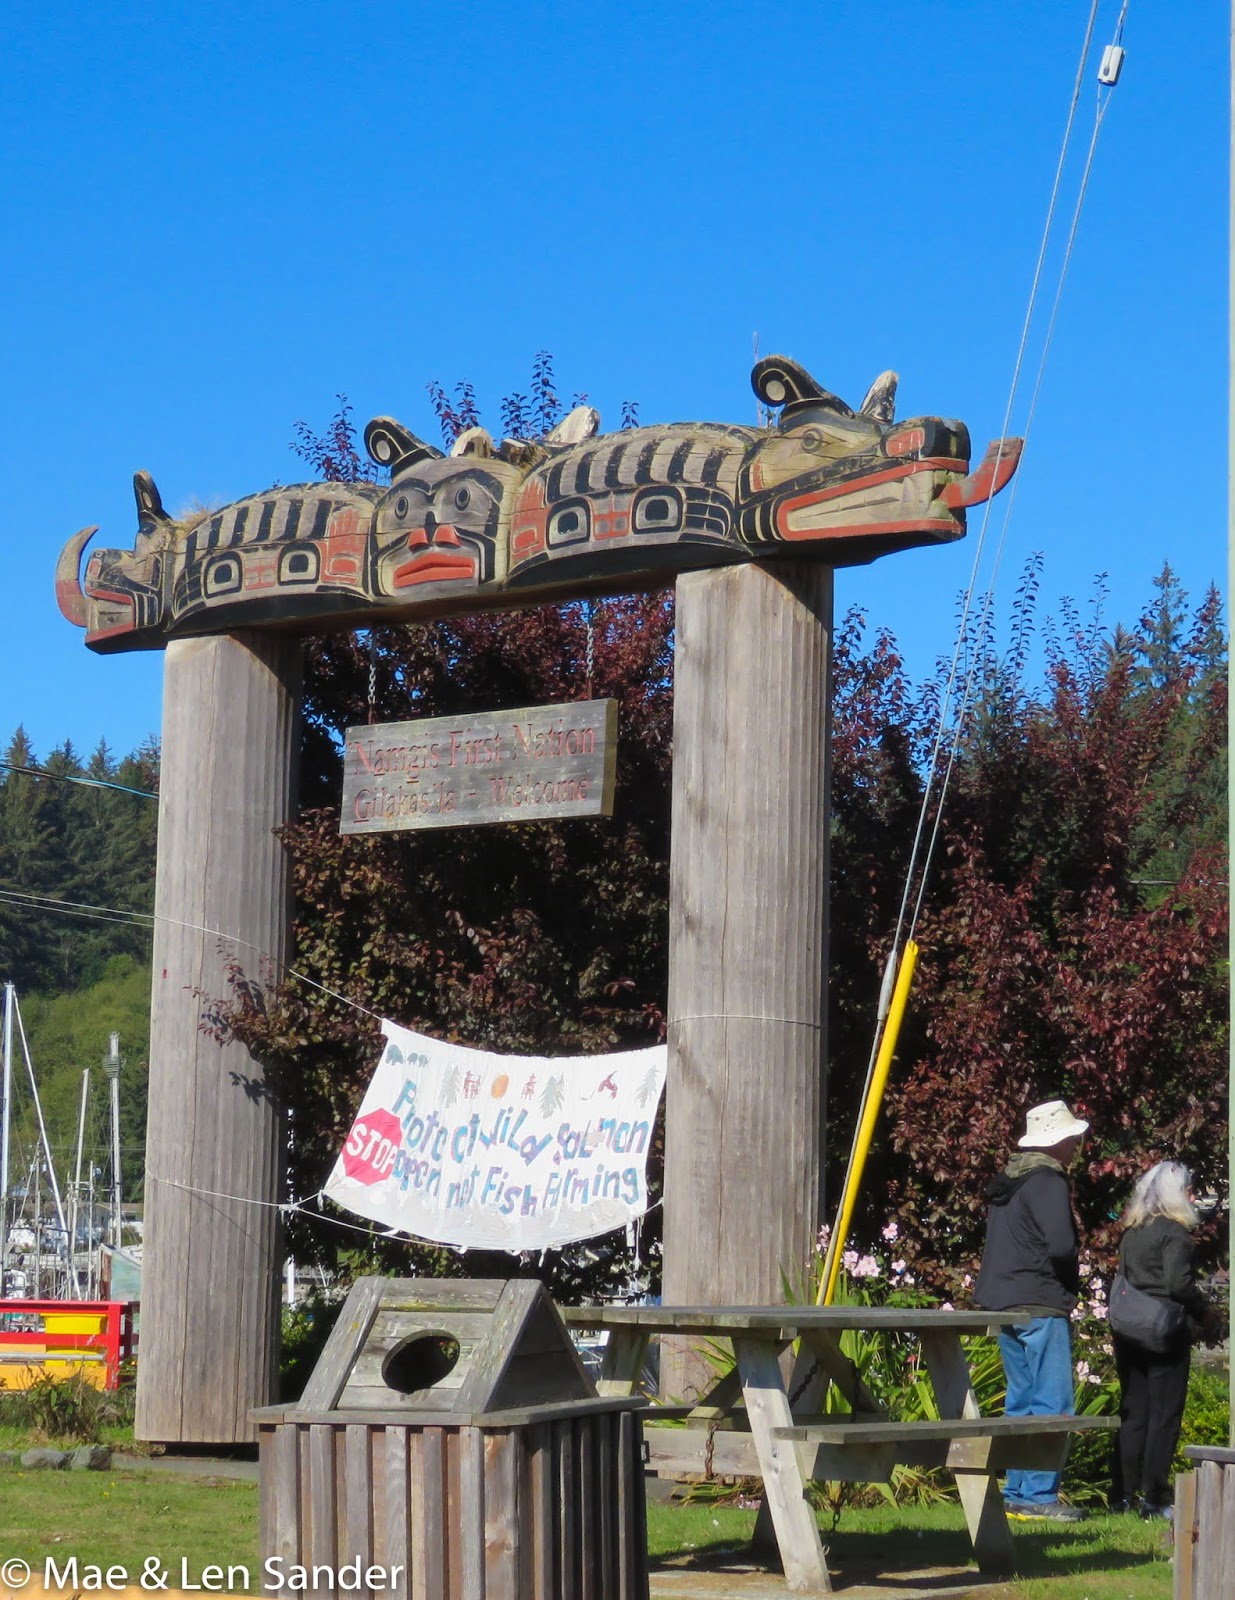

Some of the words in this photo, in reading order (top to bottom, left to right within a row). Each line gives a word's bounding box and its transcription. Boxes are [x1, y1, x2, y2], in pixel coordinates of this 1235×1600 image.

[449, 728, 501, 767] First
[512, 718, 595, 760] Nation
[489, 774, 590, 807] Welcome
[346, 1123, 399, 1174] STOP
[481, 1166, 538, 1217] Fish
